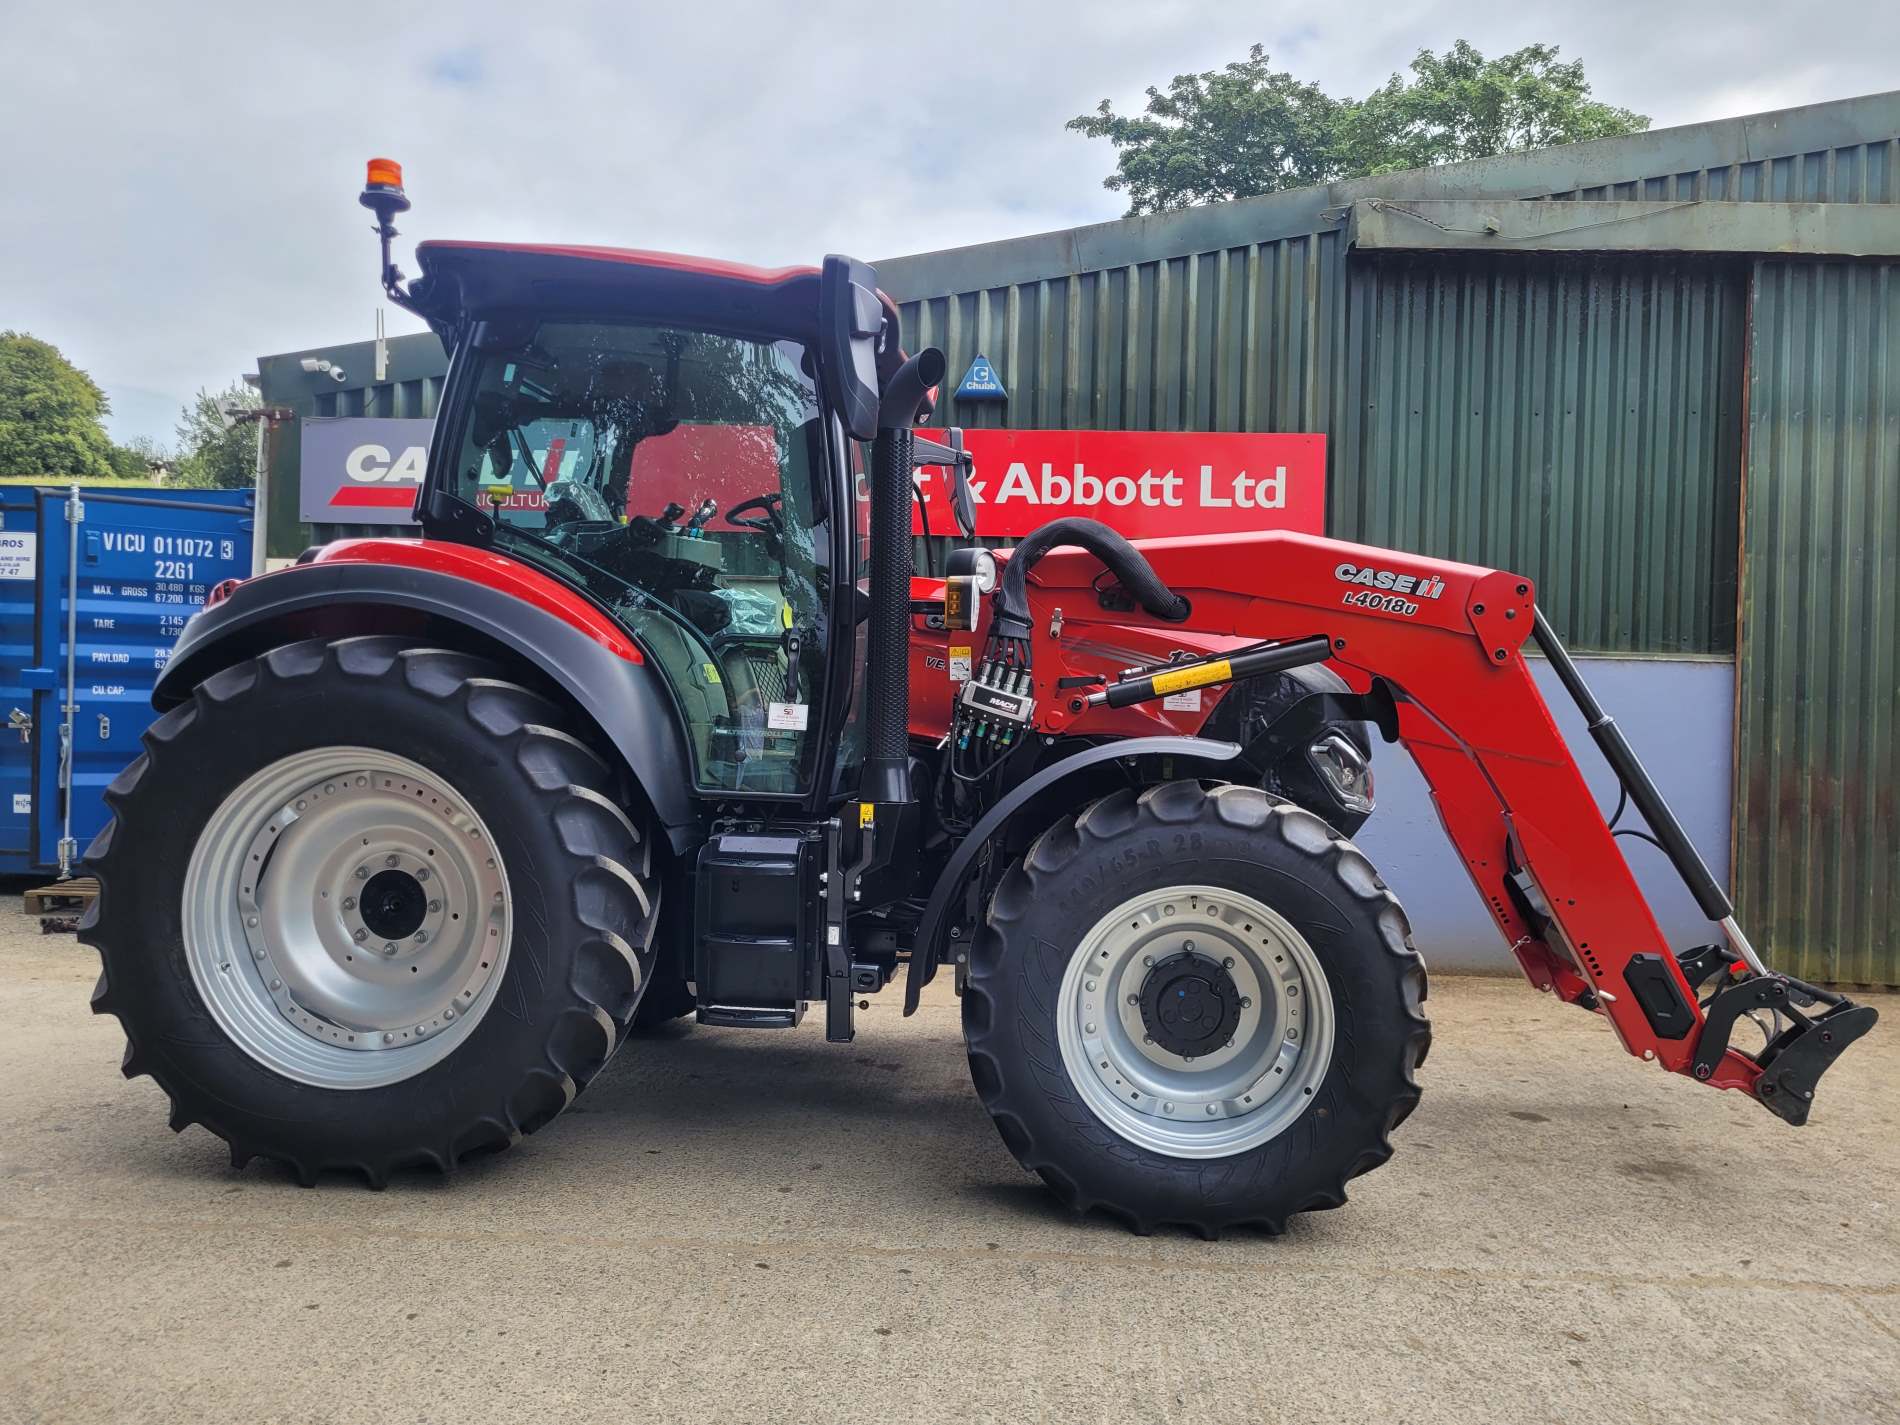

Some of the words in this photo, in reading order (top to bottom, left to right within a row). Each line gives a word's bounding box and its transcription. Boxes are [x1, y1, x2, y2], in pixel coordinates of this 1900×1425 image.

[966, 381, 996, 390] Chubb
[994, 462, 1184, 507] Abbott
[1199, 464, 1287, 509] Ltd
[103, 532, 146, 553] VICU
[153, 536, 214, 558] 011072
[222, 541, 233, 560] 3
[154, 561, 194, 580] 22G1
[1333, 562, 1417, 594] CASE
[92, 584, 115, 596] MAX.
[121, 586, 148, 597] GROSS
[155, 582, 184, 592] 30.480
[189, 584, 205, 594] KGS
[154, 593, 184, 604] 67.200
[189, 595, 205, 605] LBS
[93, 618, 115, 630] TARE
[160, 615, 184, 626] 2.145
[91, 651, 129, 663] PAYLOAD
